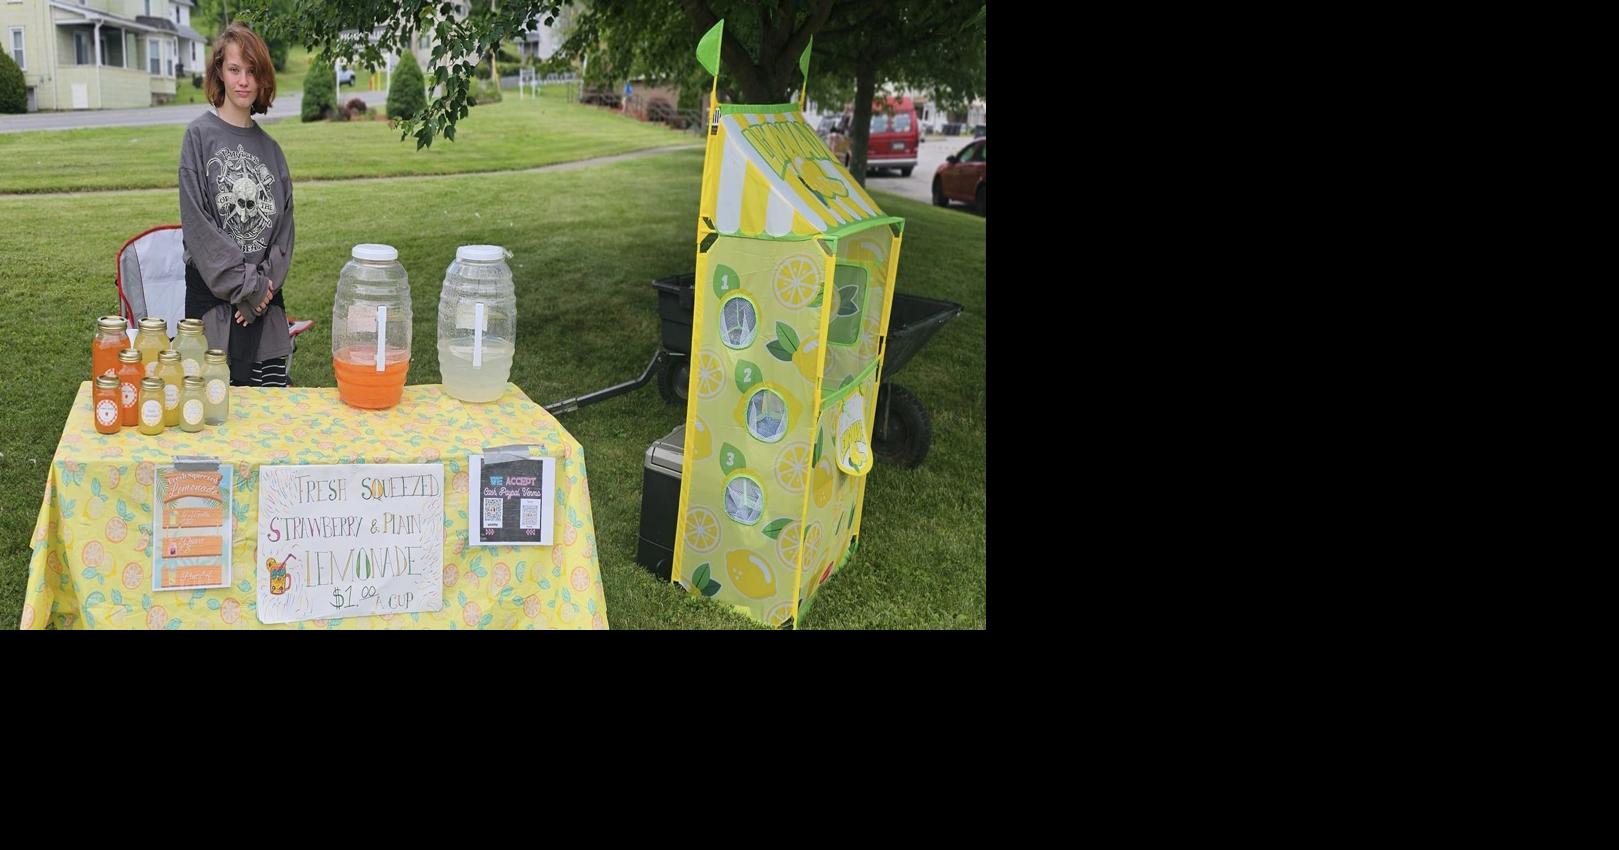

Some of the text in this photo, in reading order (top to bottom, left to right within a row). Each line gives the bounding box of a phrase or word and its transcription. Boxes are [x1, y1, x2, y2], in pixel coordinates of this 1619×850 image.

[721, 274, 729, 290] 1
[744, 367, 752, 383] 2
[726, 452, 735, 466] 3
[295, 474, 440, 503] FRESH SQUEEZED
[489, 476, 537, 486] WE ACCEPT
[267, 512, 422, 542] STRAWBERRY & PLAIN
[305, 546, 422, 587] LEMONADE
[389, 592, 414, 609] CUP
